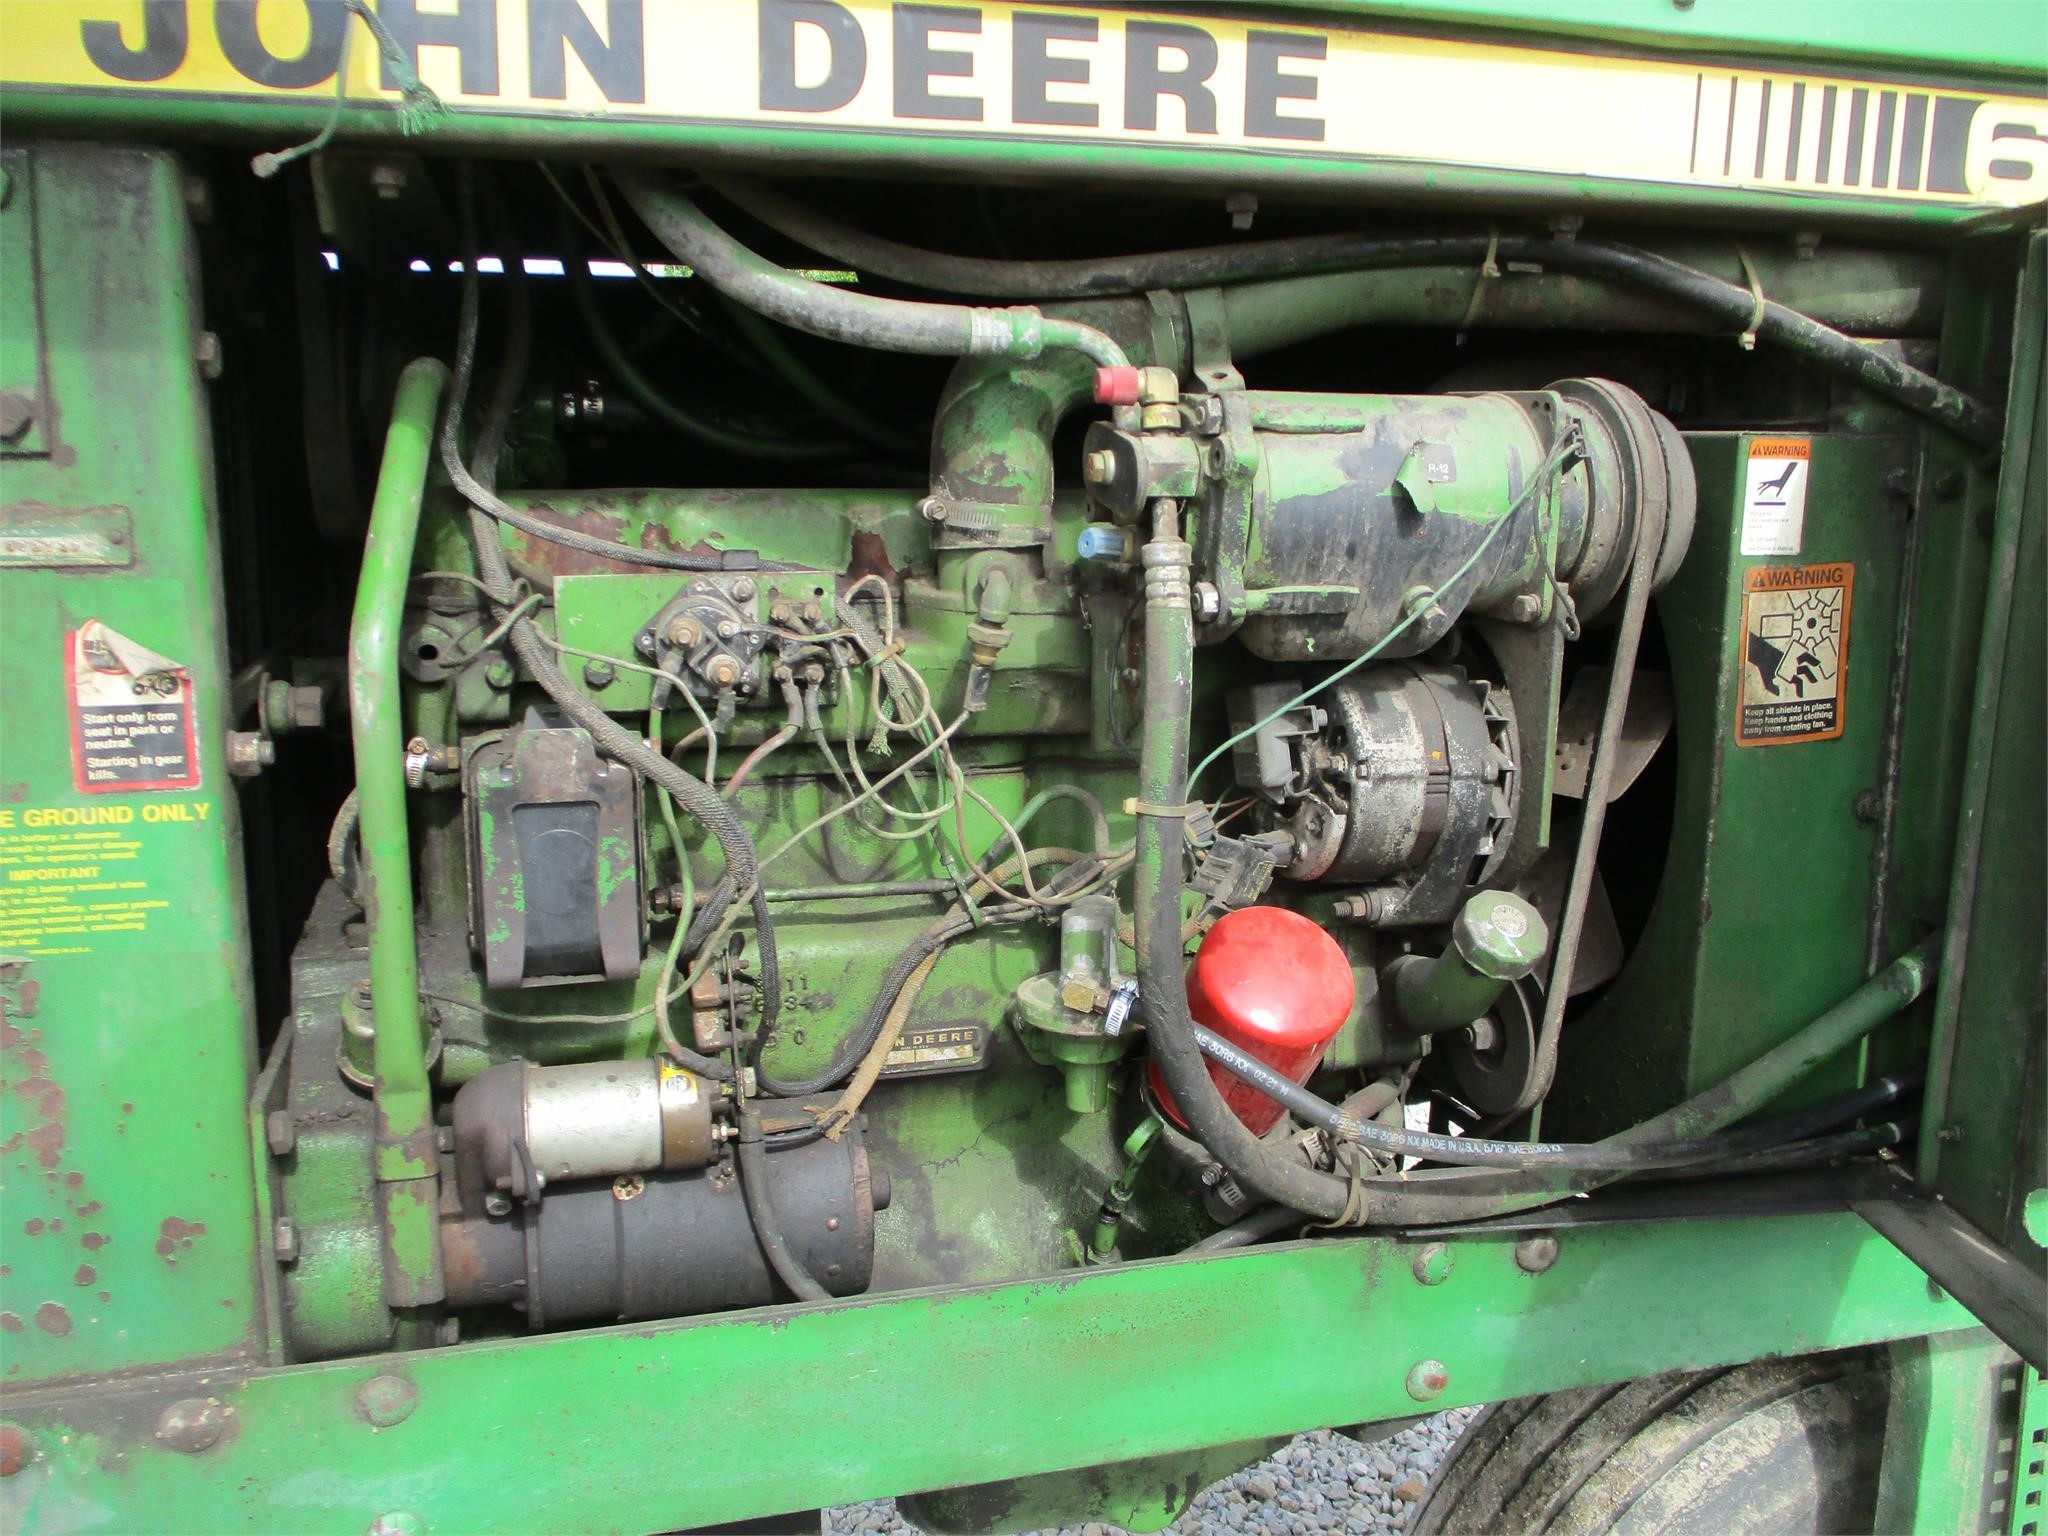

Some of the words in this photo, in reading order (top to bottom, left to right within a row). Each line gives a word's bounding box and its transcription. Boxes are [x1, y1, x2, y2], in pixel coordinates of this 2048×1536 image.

[81, 0, 645, 104] JOHN
[758, 0, 1327, 141] DEERE
[1763, 445, 1807, 456] WARNING
[1428, 463, 1449, 473] R-12
[1768, 568, 1844, 587] WARNING
[1745, 708, 1764, 717] Keep
[1765, 707, 1774, 715] all
[1776, 705, 1801, 714] shields
[1803, 704, 1810, 712] in
[1811, 703, 1833, 712] place.
[82, 713, 115, 725] Start
[116, 712, 145, 725] only
[147, 711, 178, 722] from
[1765, 716, 1787, 724] hands
[1789, 714, 1803, 722] and
[1804, 711, 1833, 720] clothing
[84, 727, 112, 737] seat
[113, 725, 128, 736] in
[129, 724, 159, 737] park
[159, 725, 176, 734] or
[1744, 727, 1764, 735] away
[1764, 725, 1781, 733] from
[1783, 722, 1811, 731] rotating
[1812, 720, 1826, 728] fan.
[85, 739, 135, 750] neutral.
[86, 756, 138, 769] Starting
[140, 755, 154, 766] in
[154, 755, 184, 767] gear
[88, 769, 119, 780] kills.
[23, 805, 135, 828] GROUND
[141, 802, 210, 823] ONLY
[9, 866, 101, 881] IMPORTANT
[912, 1031, 974, 1046] DEERE
[1194, 1030, 1209, 1047] AE
[1359, 1125, 1378, 1140] SAE
[1422, 1138, 1446, 1151] MADE
